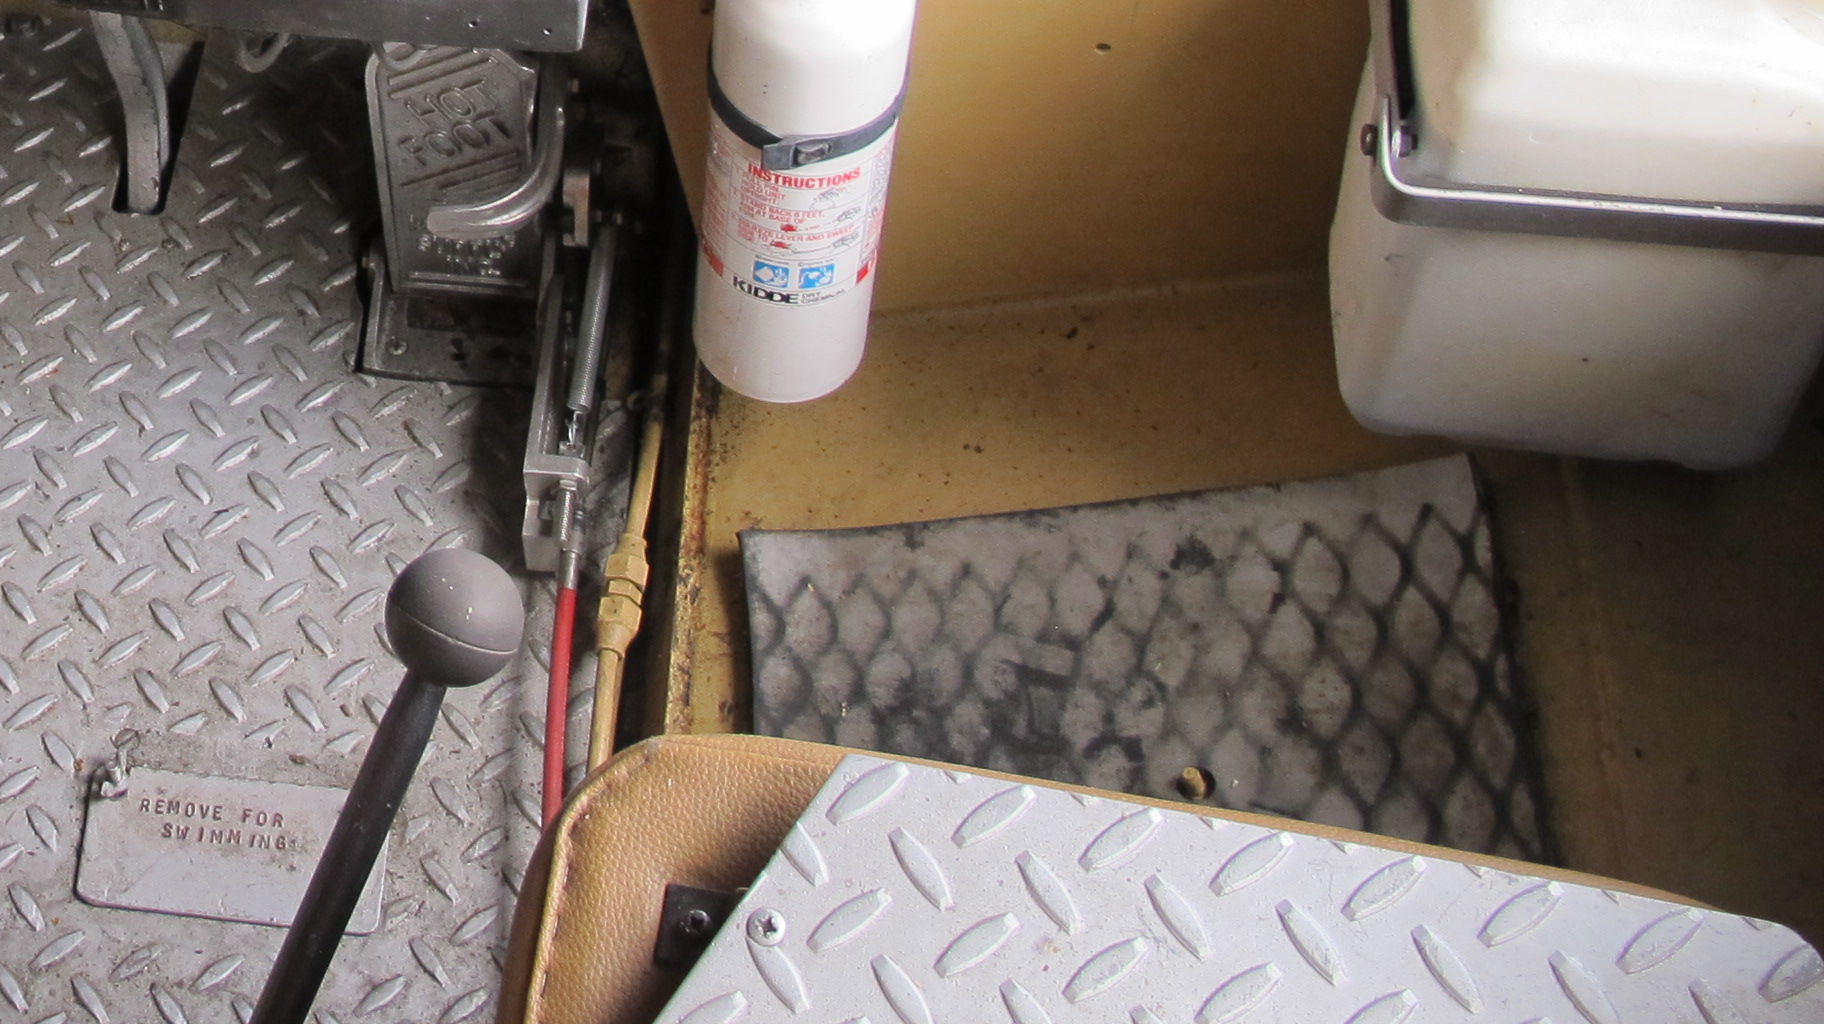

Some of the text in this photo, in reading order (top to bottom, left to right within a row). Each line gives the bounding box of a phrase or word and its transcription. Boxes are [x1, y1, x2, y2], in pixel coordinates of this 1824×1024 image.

[406, 78, 497, 126] HOT
[748, 163, 861, 189] INSTRUCTIONS
[776, 233, 803, 242] LEVER
[805, 233, 825, 242] AND
[733, 275, 798, 304] KIDDE
[139, 797, 285, 828] REMOVE FOR
[161, 822, 287, 850] SWIMMING
